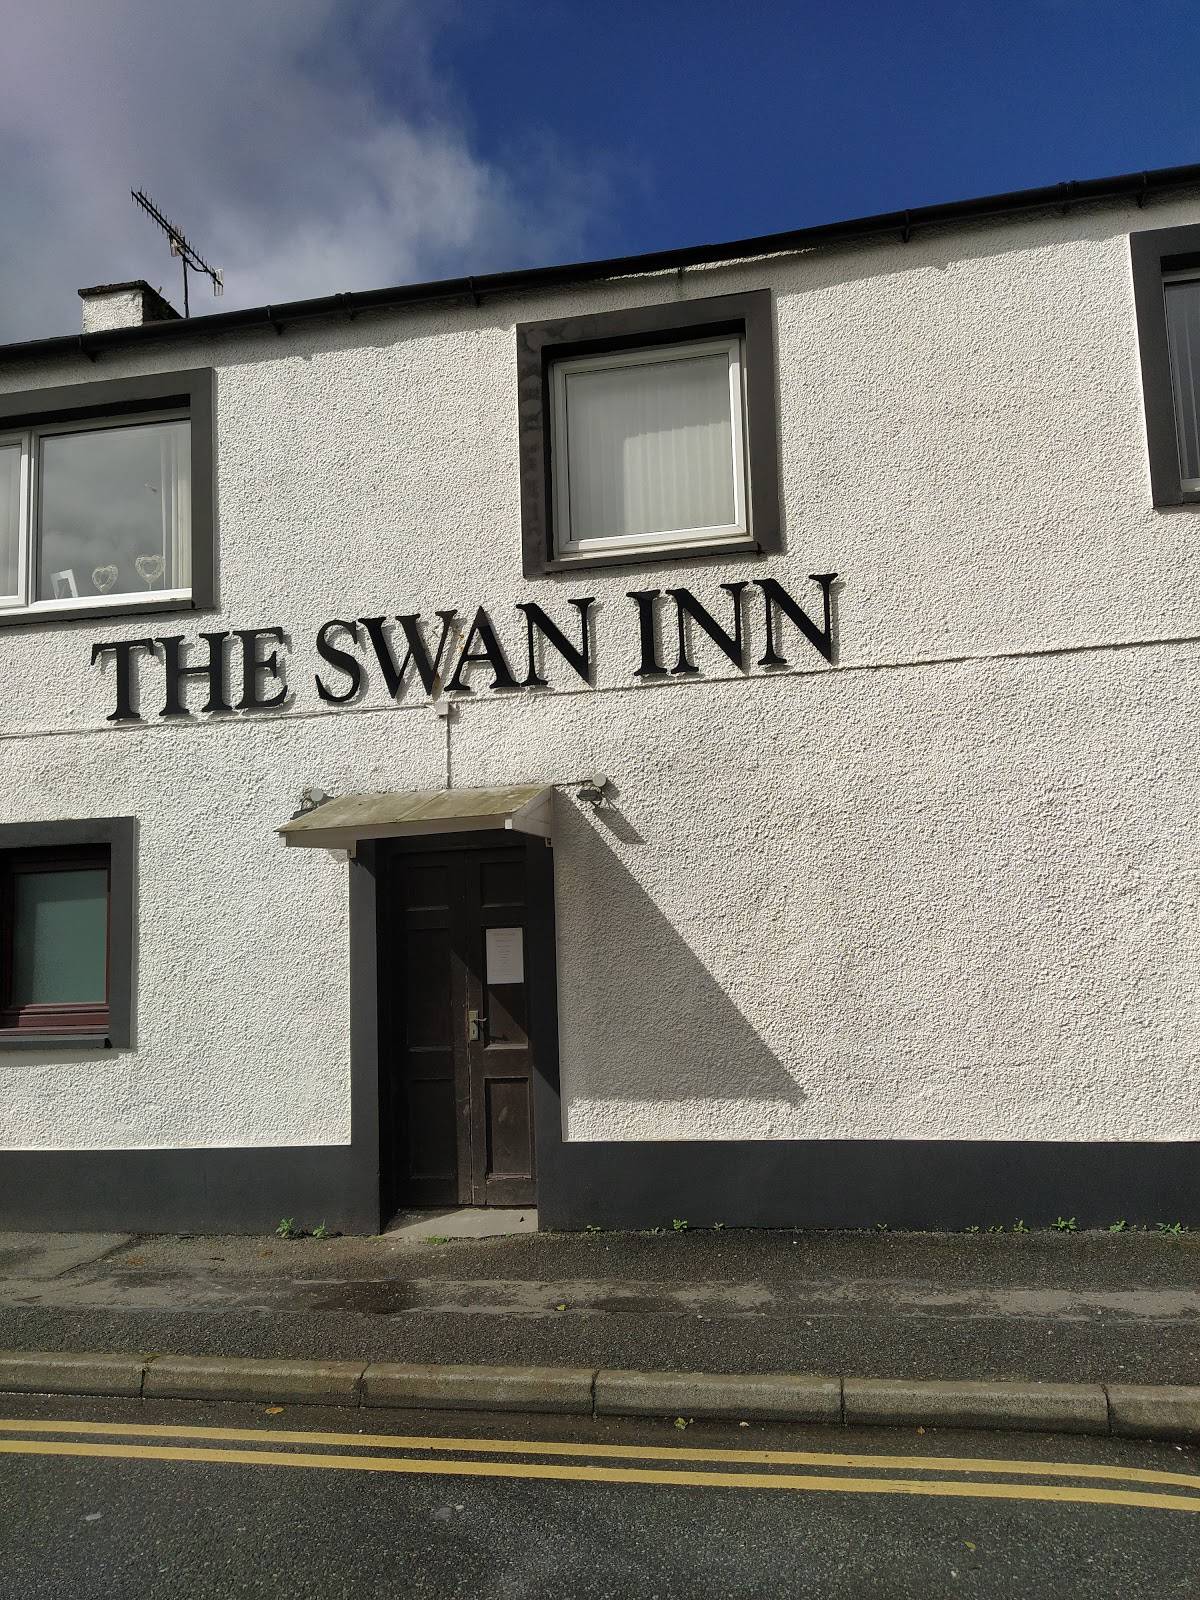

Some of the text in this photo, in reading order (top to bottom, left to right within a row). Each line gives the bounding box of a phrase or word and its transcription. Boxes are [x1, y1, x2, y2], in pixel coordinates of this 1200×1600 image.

[90, 572, 839, 721] THE SWAN INN
